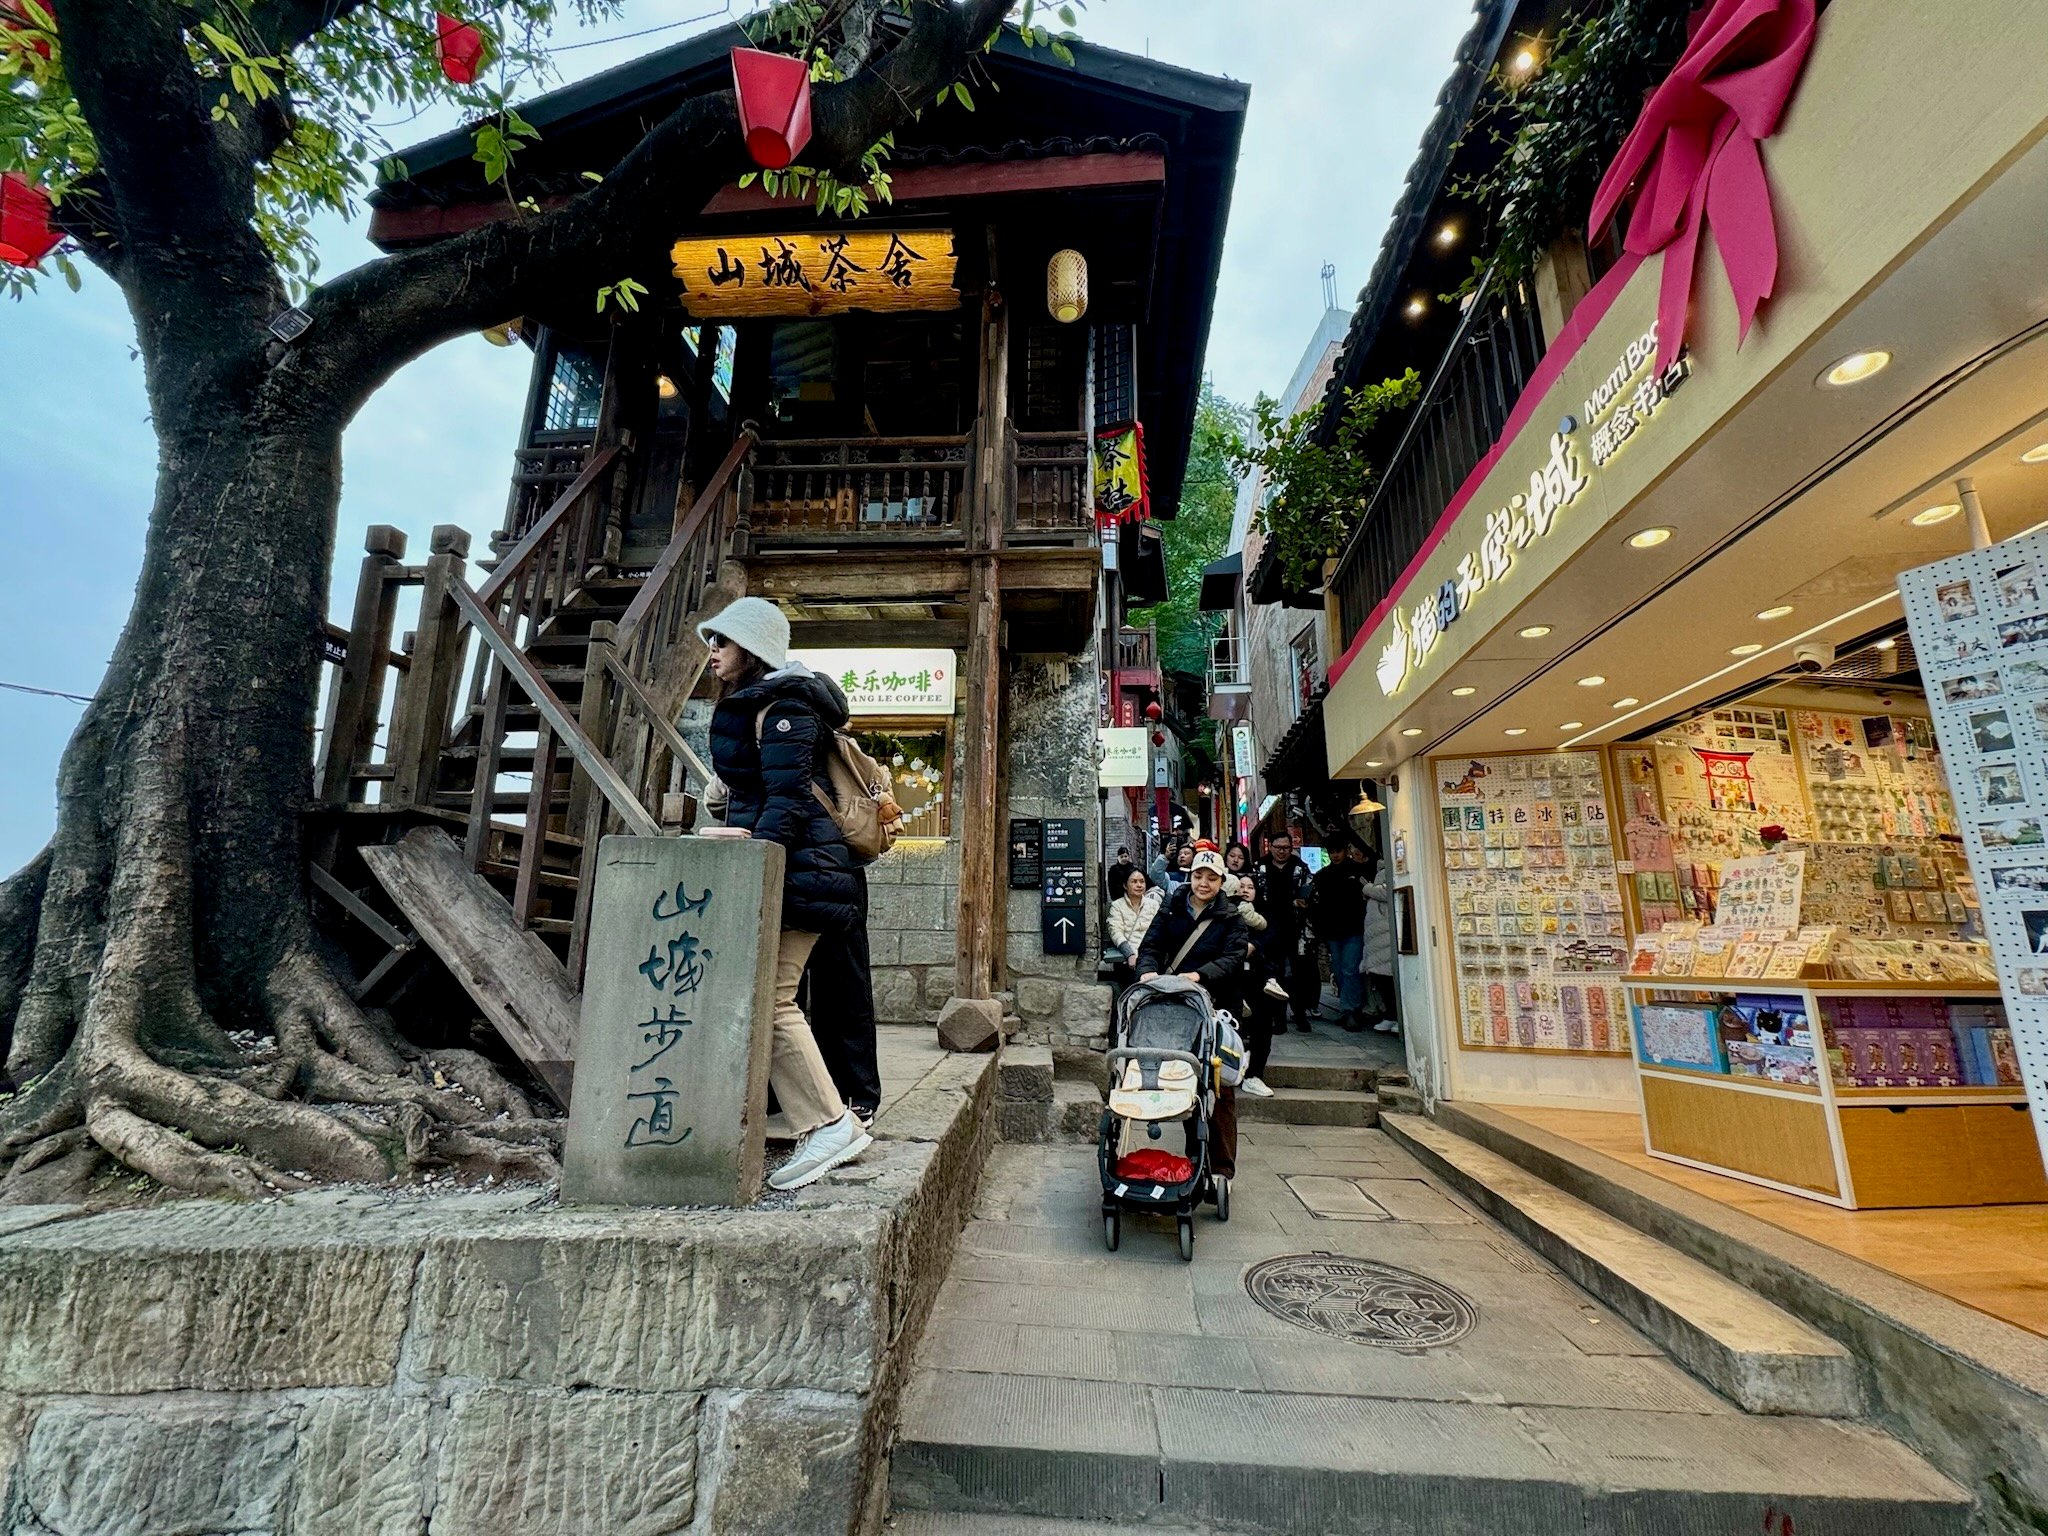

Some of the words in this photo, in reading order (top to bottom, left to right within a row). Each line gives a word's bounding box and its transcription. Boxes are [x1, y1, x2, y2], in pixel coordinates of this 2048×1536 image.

[708, 232, 928, 293] 山城茶舍
[840, 669, 932, 693] 巷乐咖啡
[878, 694, 893, 702] LE
[895, 694, 943, 702] COFFEE
[1201, 852, 1215, 864] NY
[624, 881, 713, 1149] 山城步道
